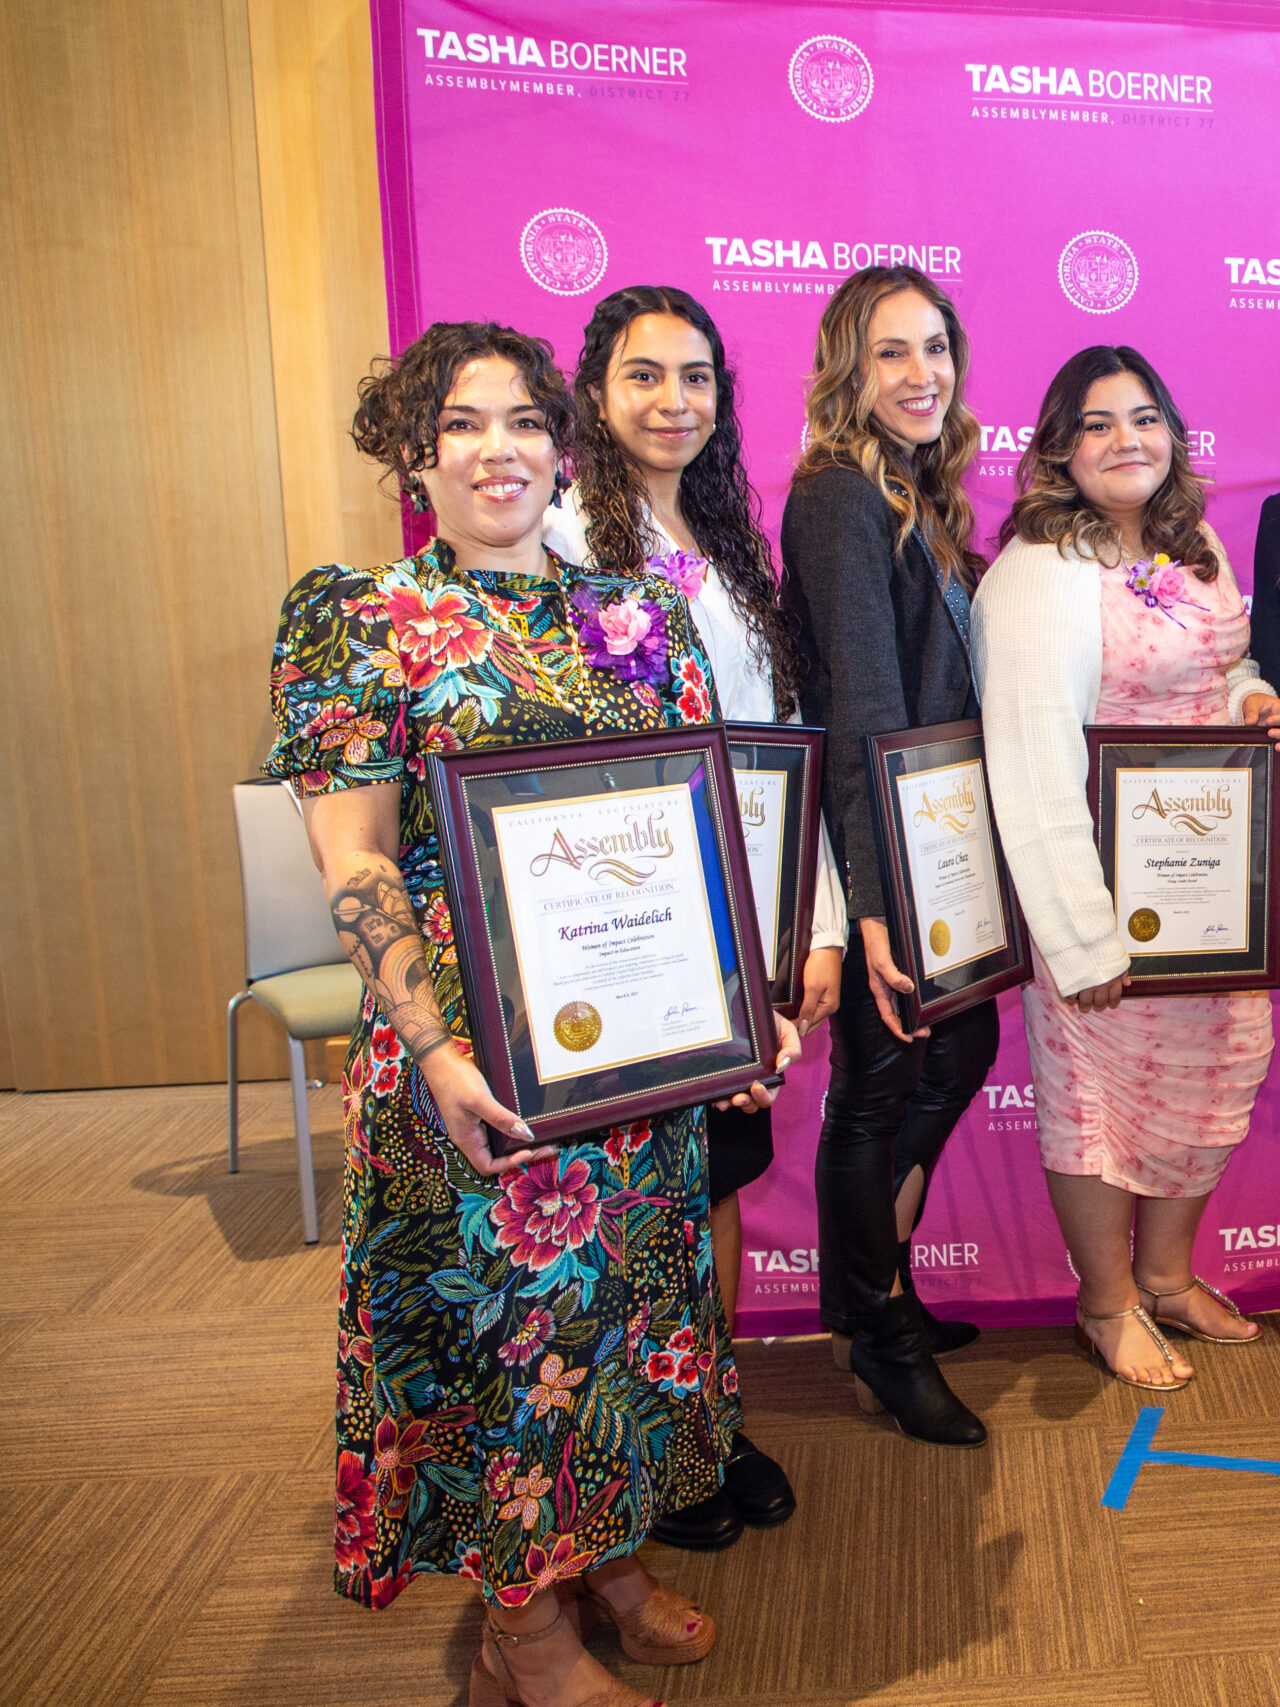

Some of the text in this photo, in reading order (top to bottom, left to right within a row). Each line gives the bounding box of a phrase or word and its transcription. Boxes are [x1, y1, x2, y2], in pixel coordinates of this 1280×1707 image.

[417, 28, 686, 78] TASHA BOERNER
[425, 72, 584, 97] ASSEMBLYMEMBER,
[965, 64, 1211, 106] TASHA BOERNER
[972, 104, 1116, 125] ASSEMBLYMEMBER,
[705, 237, 828, 269] TASHA
[713, 280, 842, 295] ASSEMBLYMEMB
[913, 776, 976, 828] Assembly
[1132, 784, 1232, 819] Assembly
[530, 808, 674, 877] Assembly
[1186, 836, 1227, 844] RECOGNITION
[937, 857, 955, 870] Laura
[1144, 857, 1221, 870] Stephanie Zuniga
[544, 882, 675, 912] CERTIFICATE OF RECOGNITION
[558, 907, 672, 941] Katrina Waidelich
